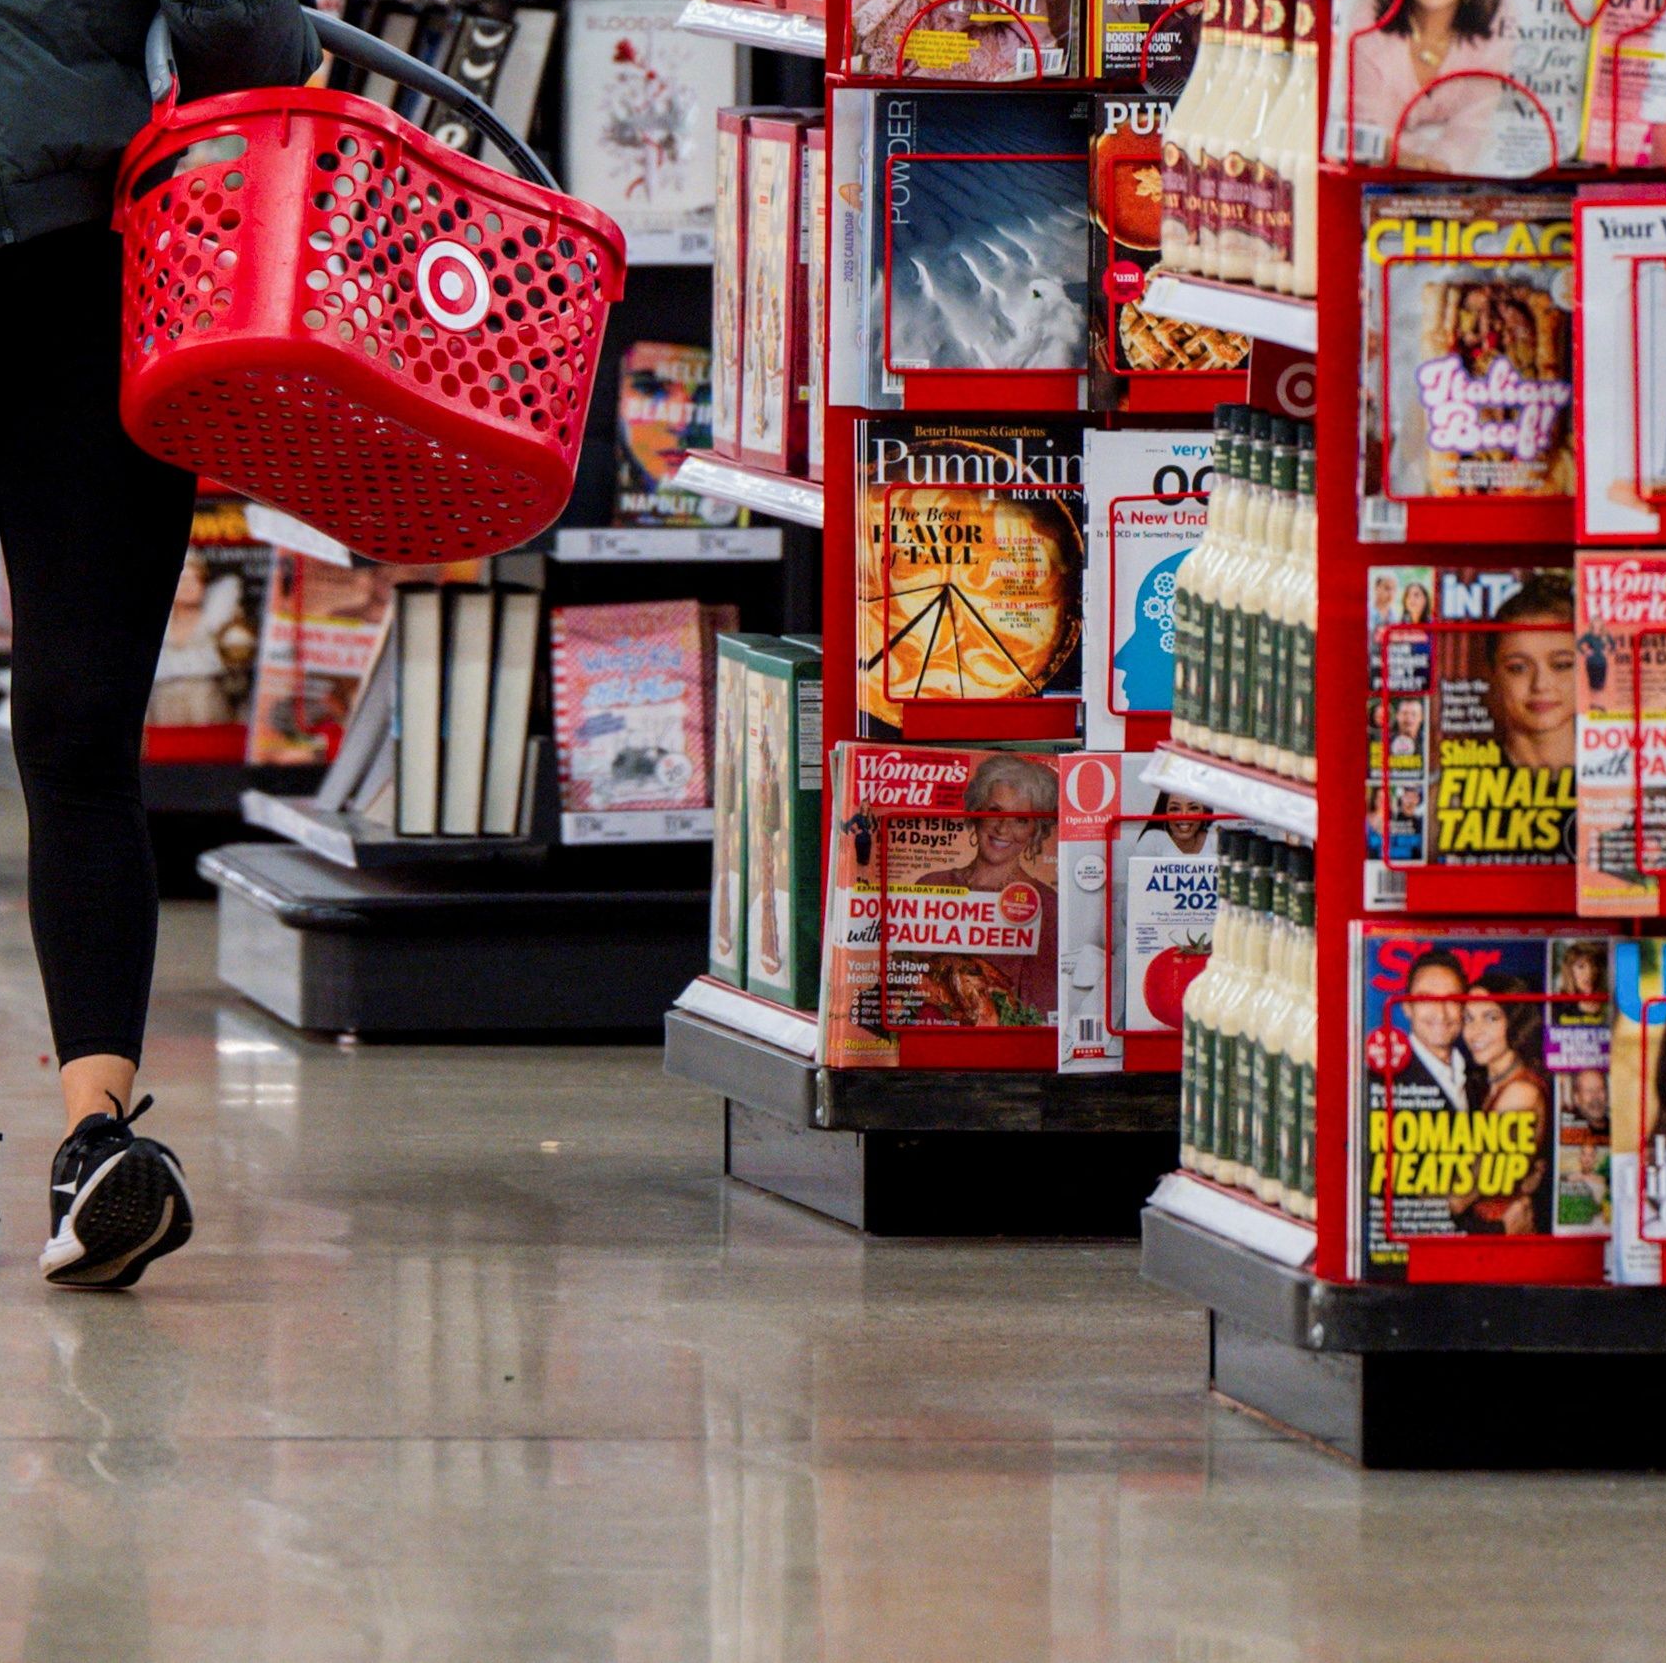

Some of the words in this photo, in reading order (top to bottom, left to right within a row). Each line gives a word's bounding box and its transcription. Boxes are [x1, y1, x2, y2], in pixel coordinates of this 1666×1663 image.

[948, 0, 966, 13] a
[1106, 32, 1134, 43] BOOST
[1106, 42, 1133, 53] LIBIDO
[887, 99, 912, 224] POWDER
[844, 210, 855, 257] CALENDAR
[1598, 216, 1656, 241] Your
[844, 258, 855, 282] 2025
[1418, 354, 1571, 407] Italian
[914, 425, 947, 437] Better
[949, 425, 989, 437] Homes
[989, 425, 999, 437] &
[999, 425, 1046, 437] Gardens
[1429, 403, 1556, 460] Beef!
[870, 438, 1083, 501] Pumpkin
[1152, 464, 1215, 506] OC
[890, 507, 921, 522] The
[926, 506, 961, 522] Best
[1130, 510, 1168, 526] New
[1173, 511, 1208, 526] Und
[873, 524, 983, 545] FLAVOR
[1142, 529, 1184, 540] Something
[903, 545, 980, 566] FALL
[856, 751, 970, 783] Woman's
[1581, 751, 1631, 778] with
[856, 780, 935, 807] World
[1065, 758, 1116, 814] O
[1438, 766, 1578, 808] FINALL
[887, 817, 922, 831] Lost
[923, 817, 940, 831] 15
[941, 817, 965, 833] lbs
[1065, 815, 1093, 826] Oprah
[1438, 807, 1562, 852] TALKS
[890, 831, 907, 844] 14
[1152, 863, 1200, 874] AMERICAN
[896, 886, 935, 895] HOLIDAY
[1173, 892, 1218, 910] 202
[849, 898, 918, 919] DOWN
[923, 899, 996, 923] HOME
[846, 920, 883, 944] with
[885, 923, 963, 946] PAULA
[967, 926, 1035, 948] DEEN
[847, 960, 872, 971] Your
[873, 960, 930, 973] Mst-Have
[886, 973, 923, 986] Guide!
[1369, 1110, 1537, 1154] ROMANCE
[1477, 1153, 1530, 1196] UP
